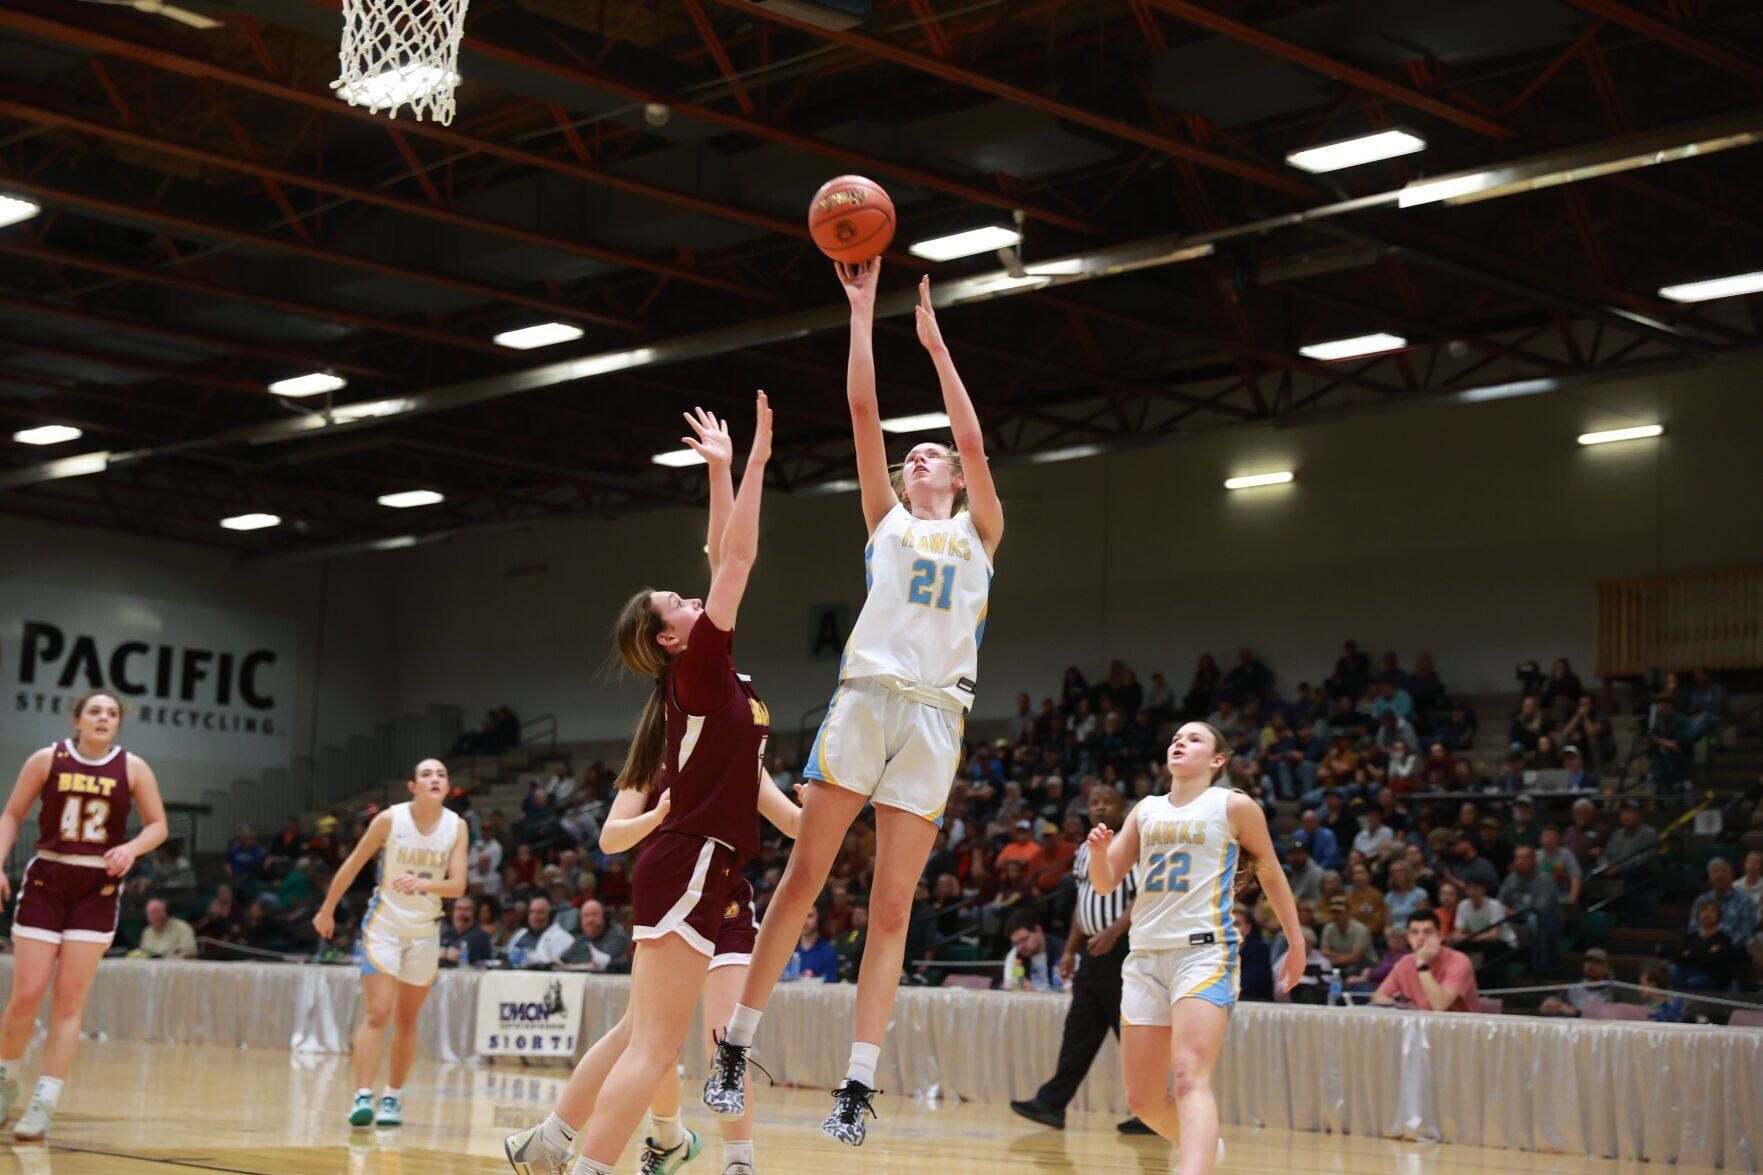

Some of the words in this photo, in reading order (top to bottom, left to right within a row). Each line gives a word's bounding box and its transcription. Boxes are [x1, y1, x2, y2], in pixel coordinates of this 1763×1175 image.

[902, 527, 972, 562] HAWKS
[907, 557, 958, 612] 21
[18, 620, 278, 711] PACIFIC
[15, 692, 62, 715] STE
[138, 705, 276, 736] RECYCLING
[58, 772, 117, 797] BELT
[60, 795, 110, 844] 42
[1141, 818, 1207, 848] HAWKS
[1144, 850, 1193, 895] 22
